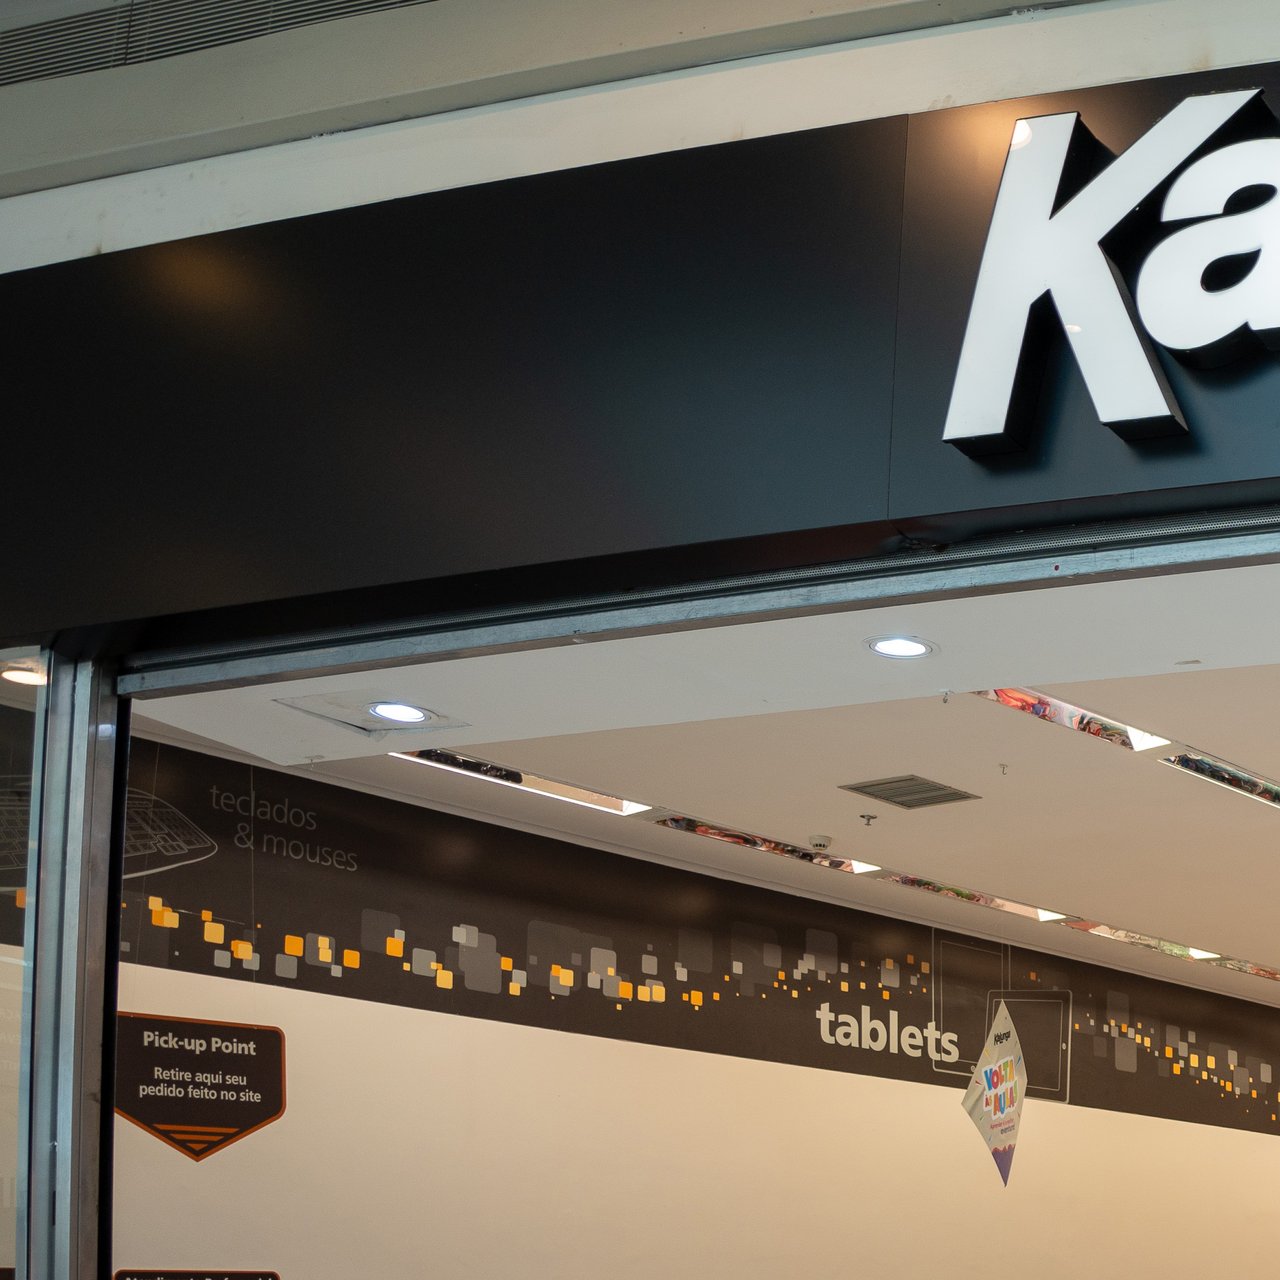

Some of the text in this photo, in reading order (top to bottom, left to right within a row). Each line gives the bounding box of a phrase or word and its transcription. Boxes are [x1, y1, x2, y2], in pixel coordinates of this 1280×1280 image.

[209, 782, 317, 832] teclados
[233, 824, 358, 872] & mouses
[144, 1031, 256, 1055] Pick-up Point
[816, 1002, 959, 1062] tablets
[139, 1084, 261, 1102] pedido feito no site
[155, 1067, 246, 1085] Retire aqui seu
